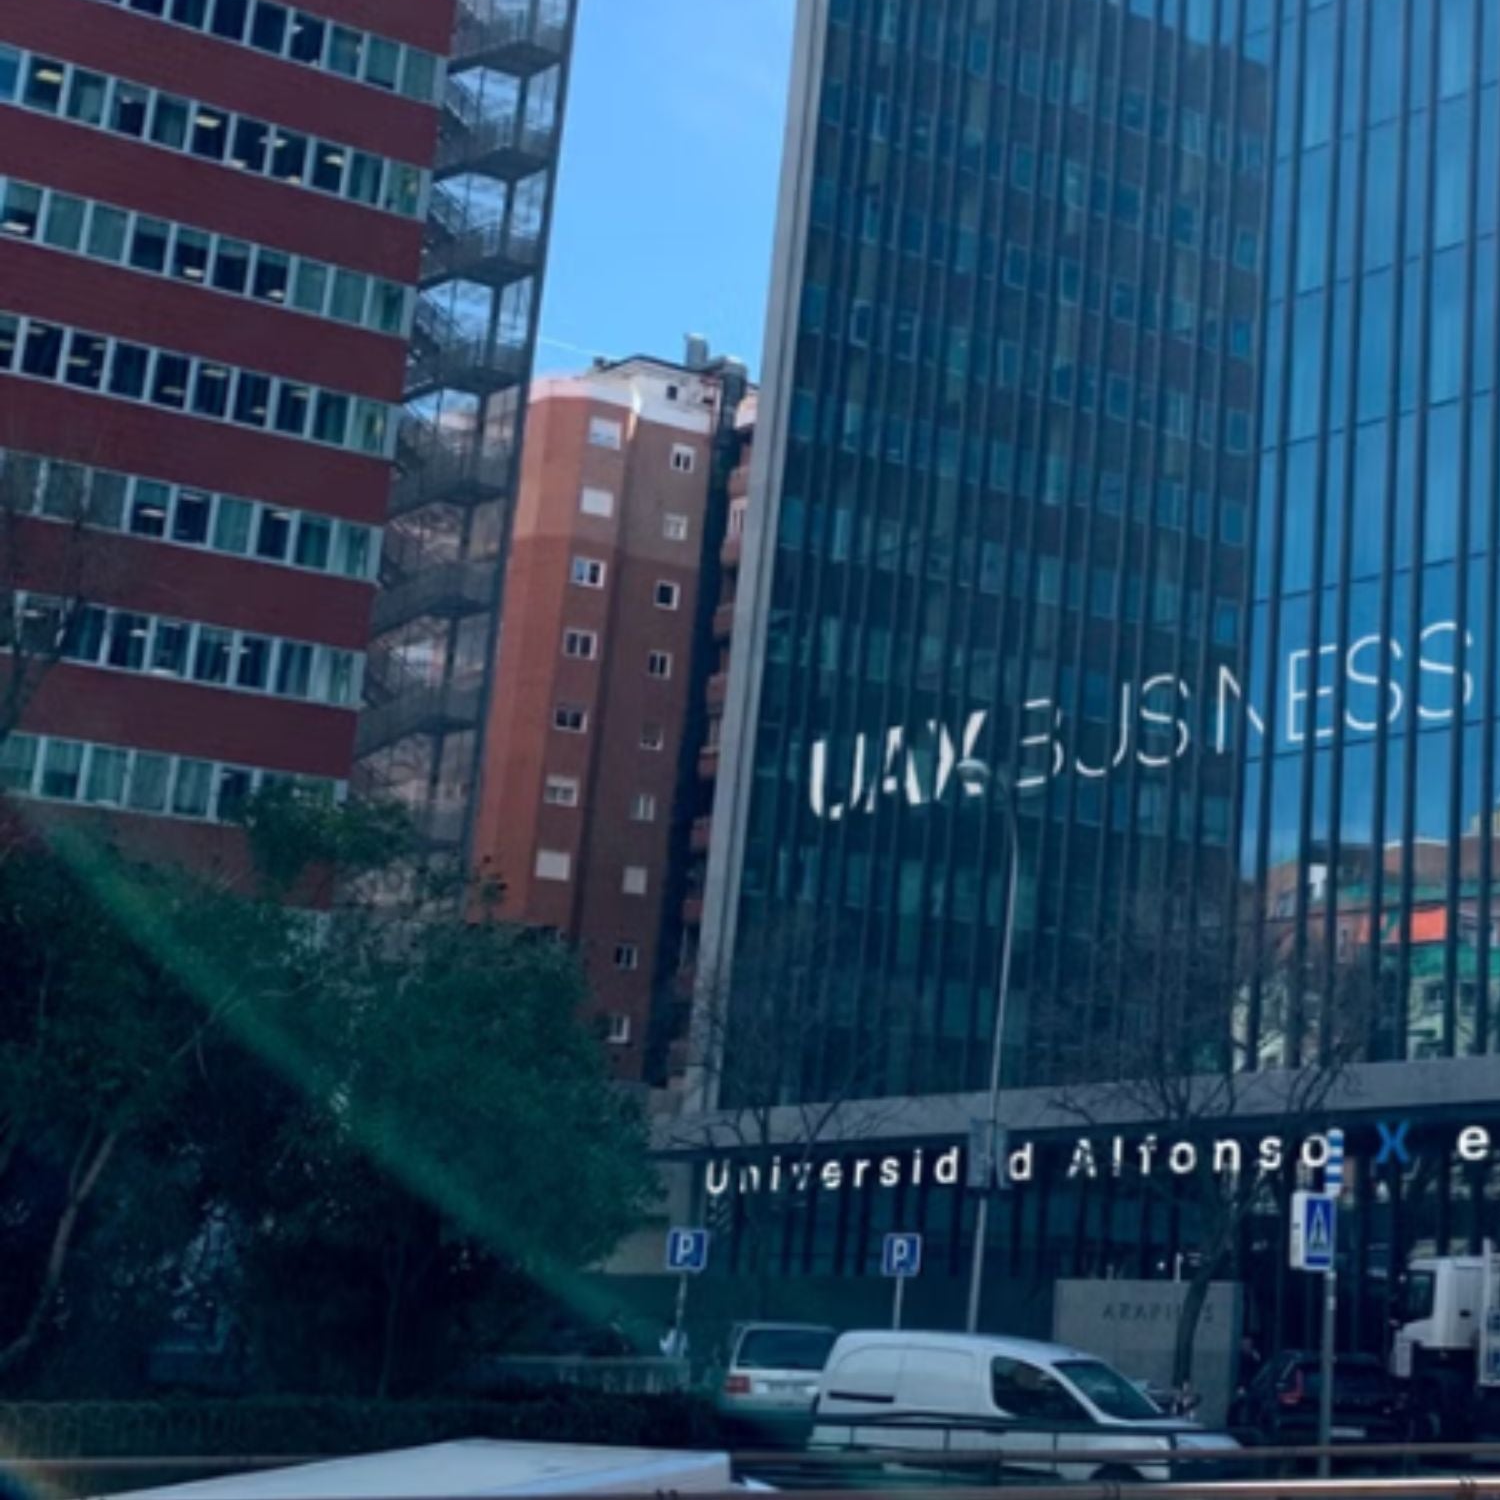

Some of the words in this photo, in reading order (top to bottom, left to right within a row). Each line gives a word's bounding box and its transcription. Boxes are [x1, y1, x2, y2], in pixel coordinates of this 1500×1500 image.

[1016, 622, 1473, 788] BUSNESS
[705, 1141, 1034, 1195] Universidd
[1376, 1121, 1411, 1164] X
[676, 1235, 695, 1264] P
[893, 1239, 909, 1267] P
